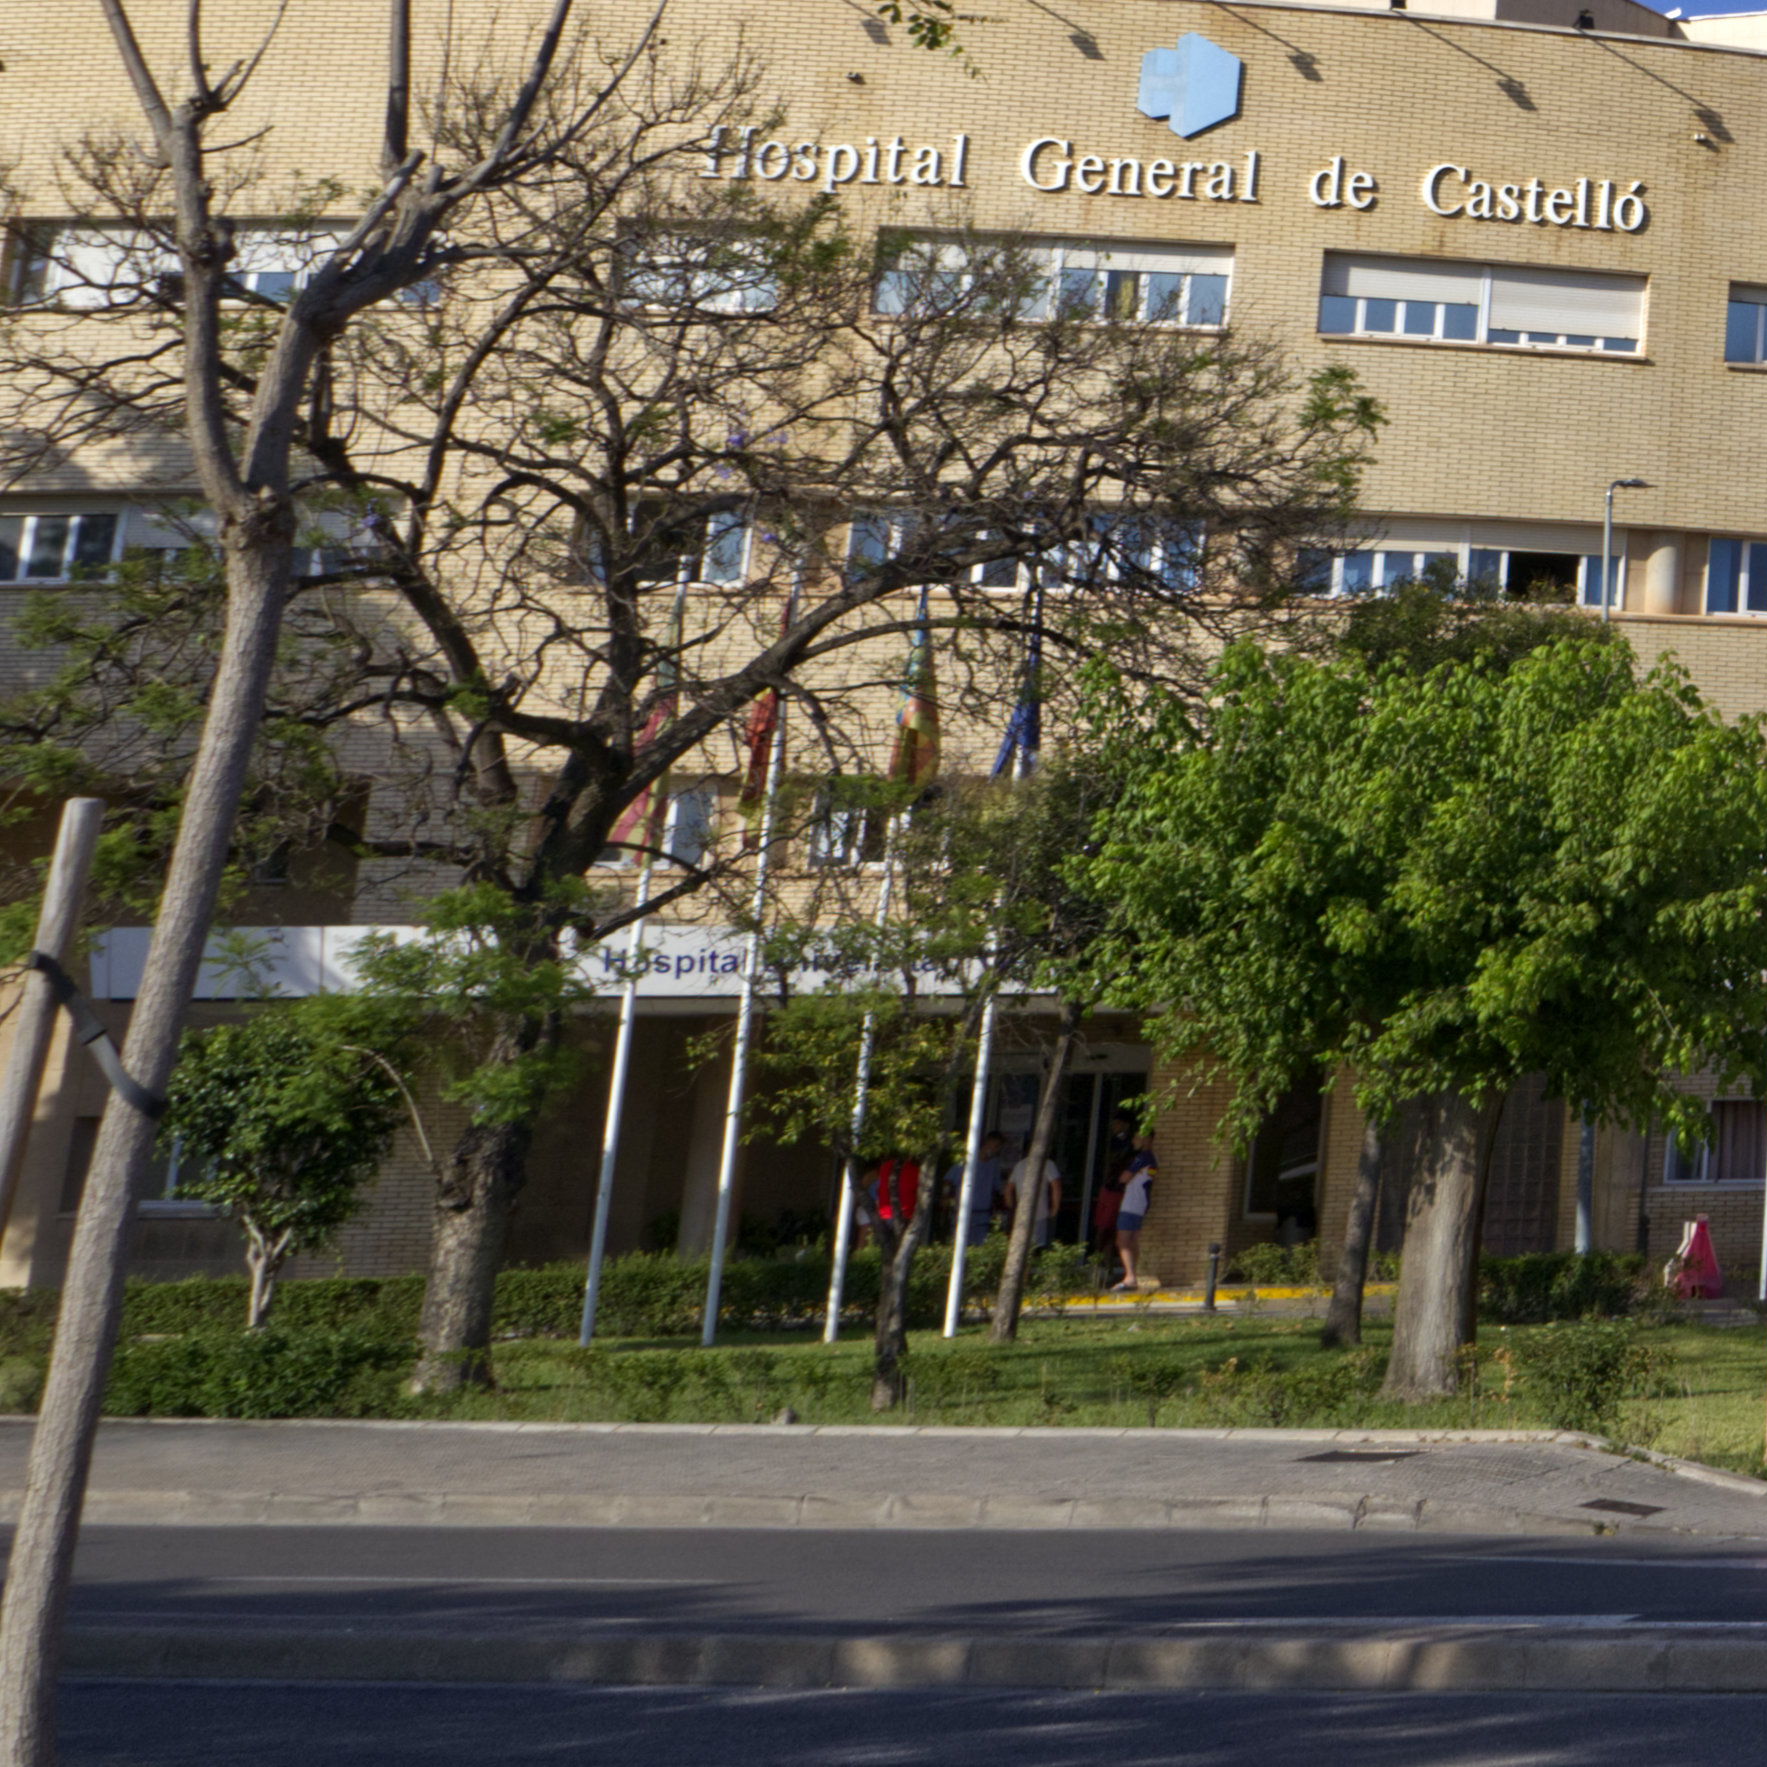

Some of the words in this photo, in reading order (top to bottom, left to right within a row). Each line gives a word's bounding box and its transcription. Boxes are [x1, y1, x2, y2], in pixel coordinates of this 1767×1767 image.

[700, 124, 969, 193] Hospital
[1021, 138, 1262, 203] General
[1309, 155, 1377, 210] de
[1422, 164, 1649, 233] Castelló
